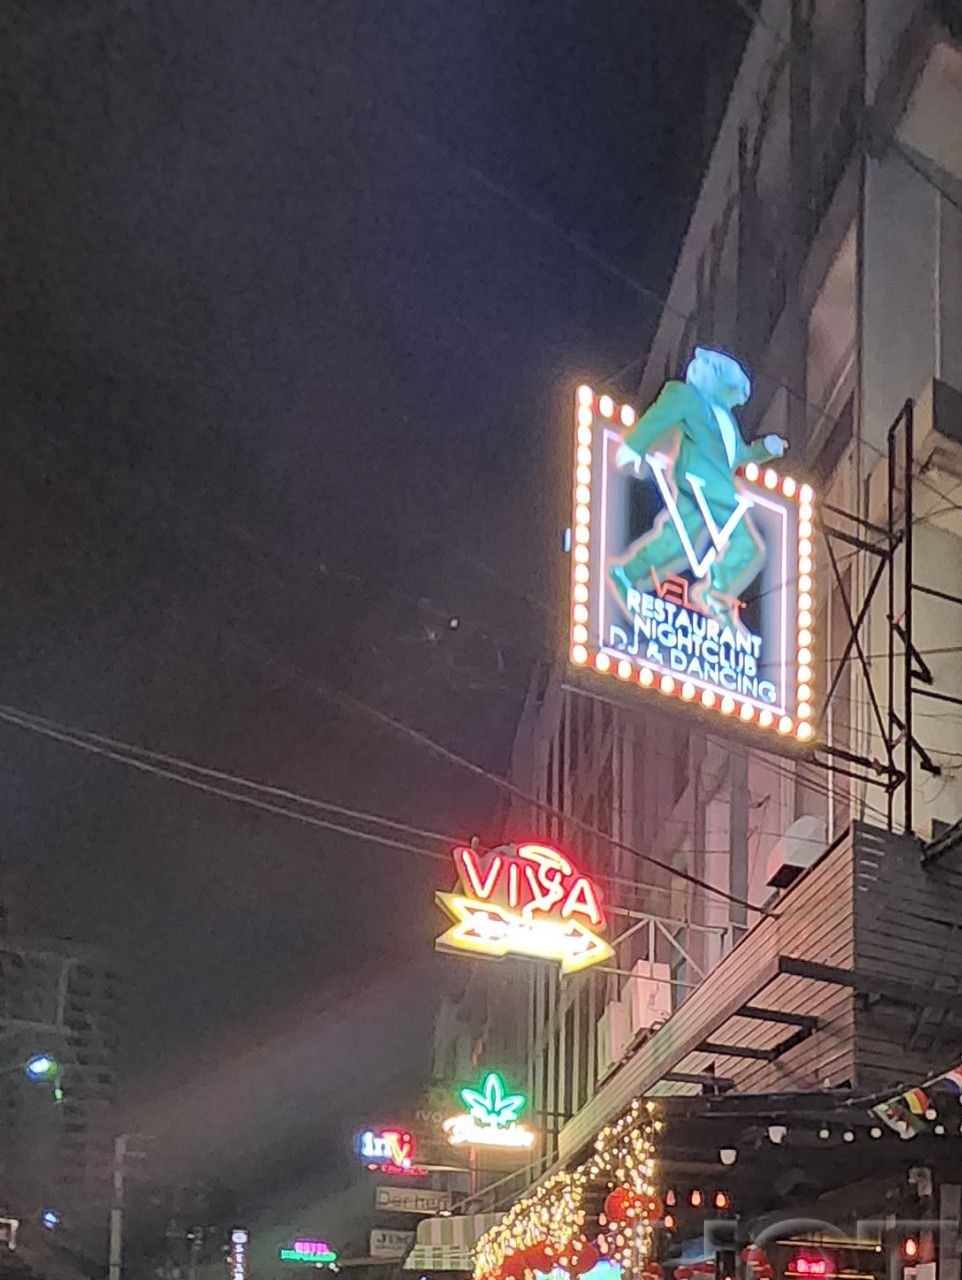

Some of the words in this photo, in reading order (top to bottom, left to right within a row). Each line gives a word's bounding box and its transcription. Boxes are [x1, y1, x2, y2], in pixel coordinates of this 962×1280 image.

[626, 587, 762, 657] RESTAURANT
[633, 613, 757, 676] NIGHTCLUB
[609, 624, 639, 655] DJ
[670, 649, 777, 703] DANCING
